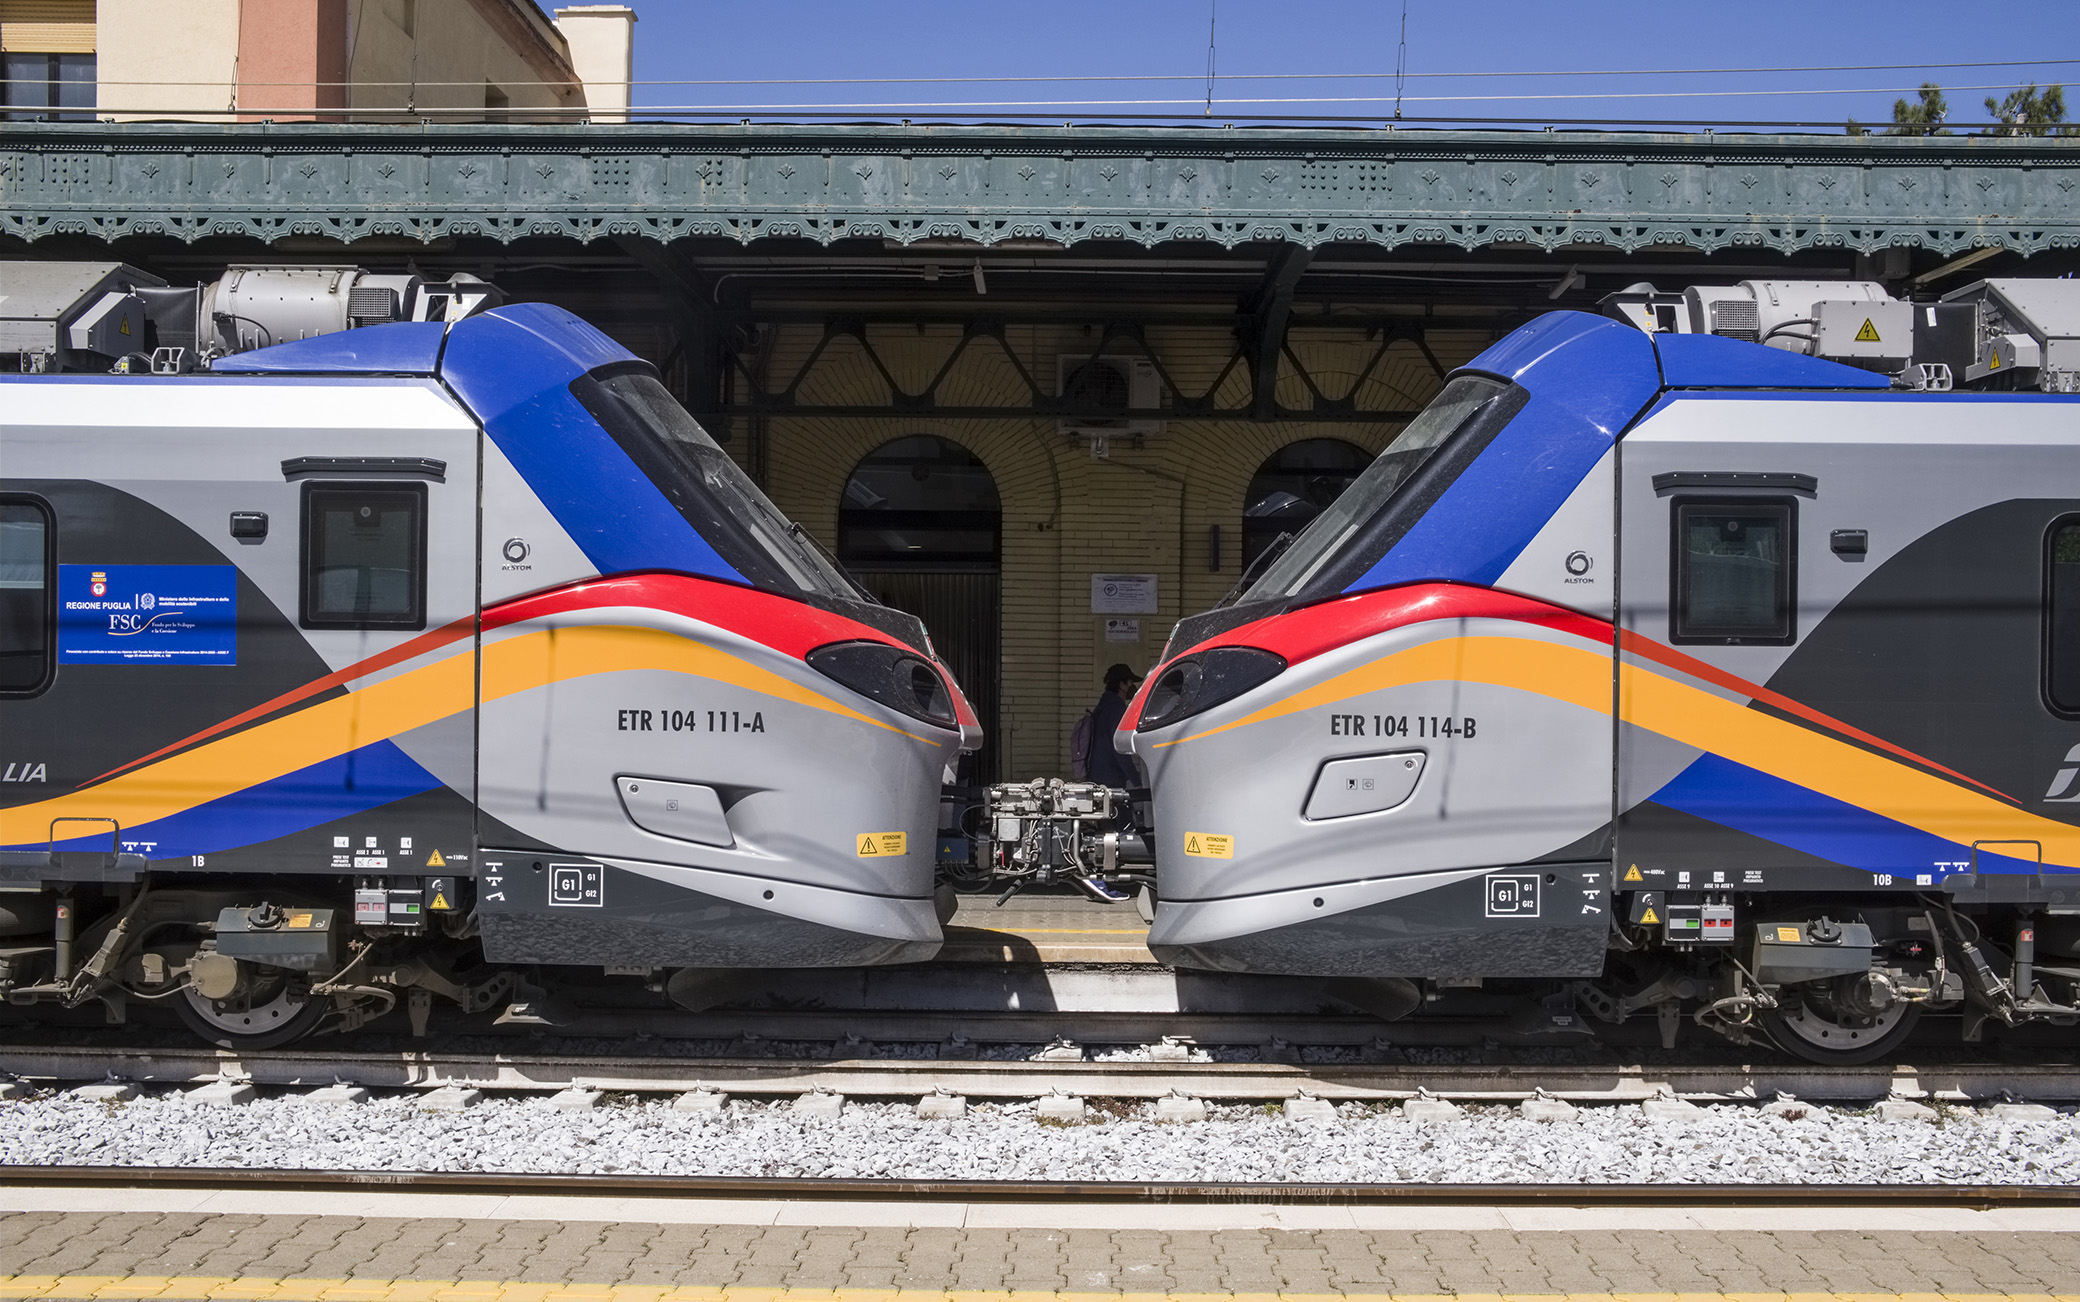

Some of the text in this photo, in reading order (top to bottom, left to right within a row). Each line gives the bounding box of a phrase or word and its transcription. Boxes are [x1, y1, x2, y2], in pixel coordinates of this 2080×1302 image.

[66, 601, 131, 610] REGIONE PUGLIA
[109, 614, 141, 630] FSC
[618, 710, 765, 733] ETR 104 111-A
[1331, 714, 1476, 739] ETR 104 114-B
[2, 763, 46, 782] LIA
[192, 856, 205, 867] 1B
[562, 879, 575, 890] G1
[1873, 874, 1892, 886] 10B
[1498, 890, 1512, 902] G1
